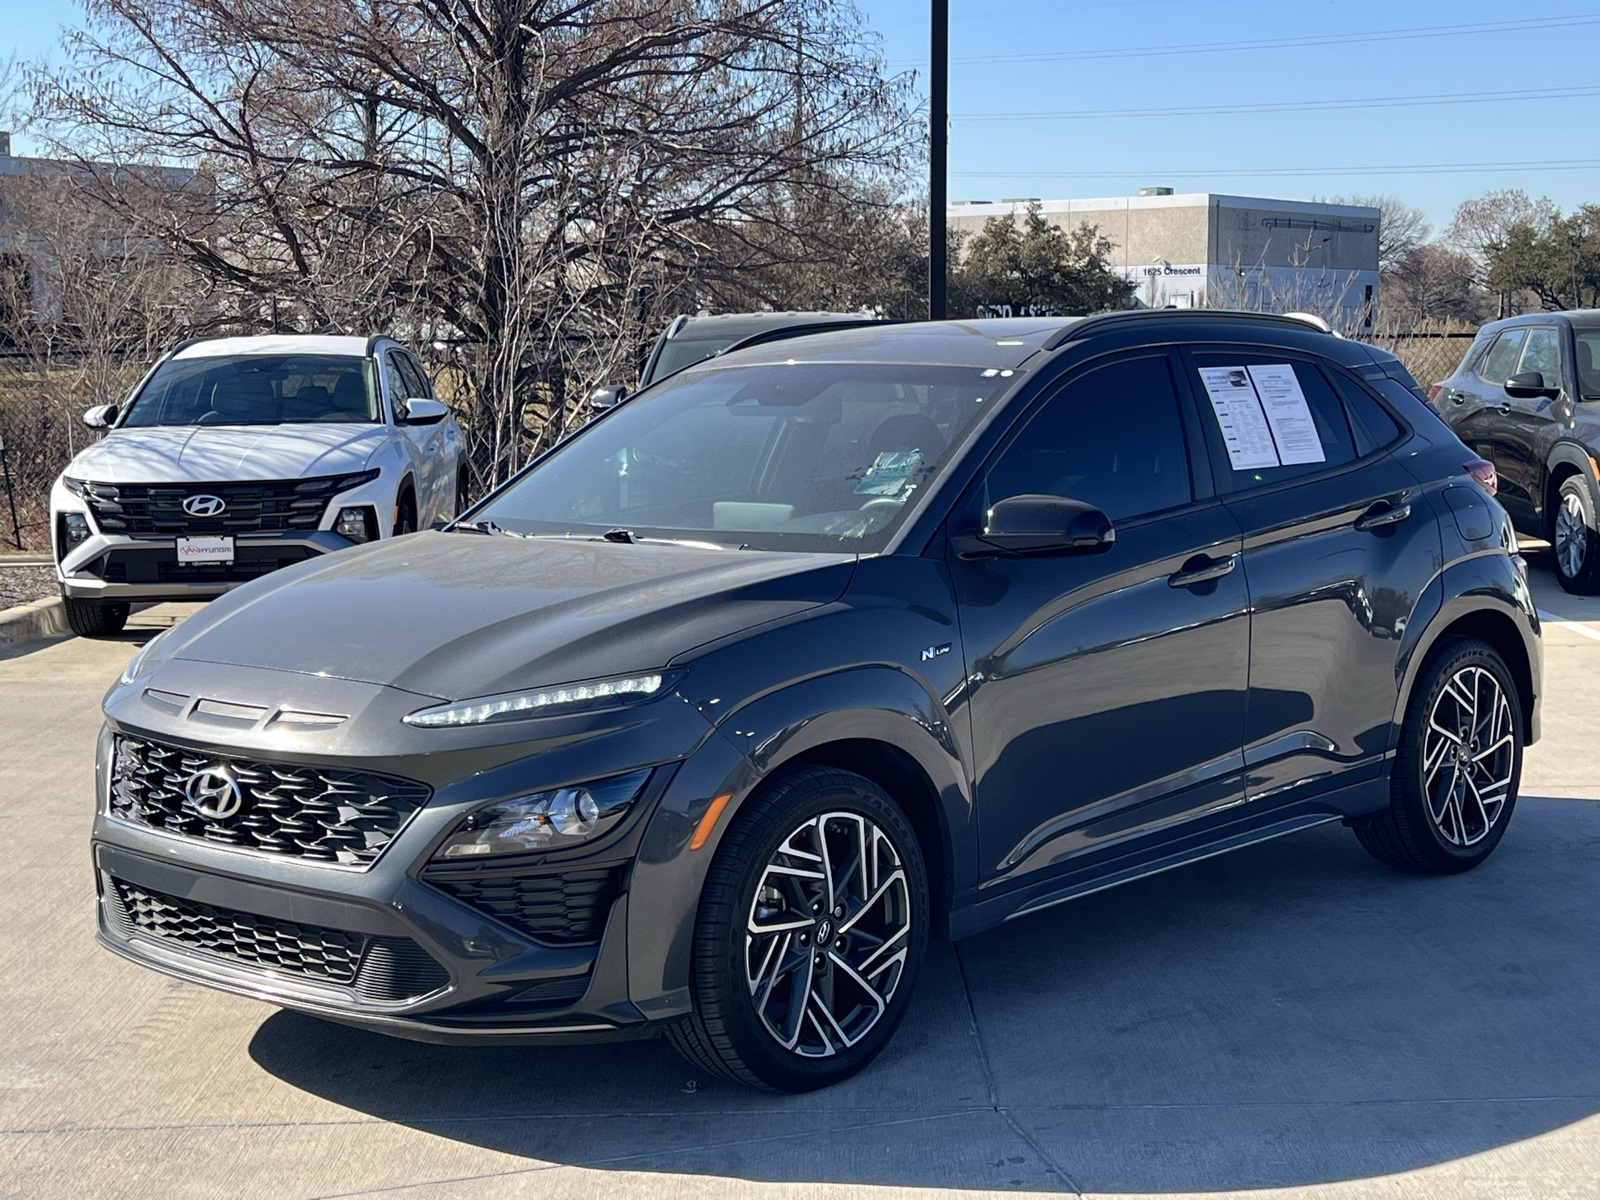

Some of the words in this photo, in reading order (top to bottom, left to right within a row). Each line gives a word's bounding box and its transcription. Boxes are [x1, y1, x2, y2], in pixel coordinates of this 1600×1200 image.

[1143, 268, 1162, 276] 1625
[1164, 267, 1201, 276] Crescent
[921, 646, 935, 661] N
[1443, 651, 1484, 674] TOURING
